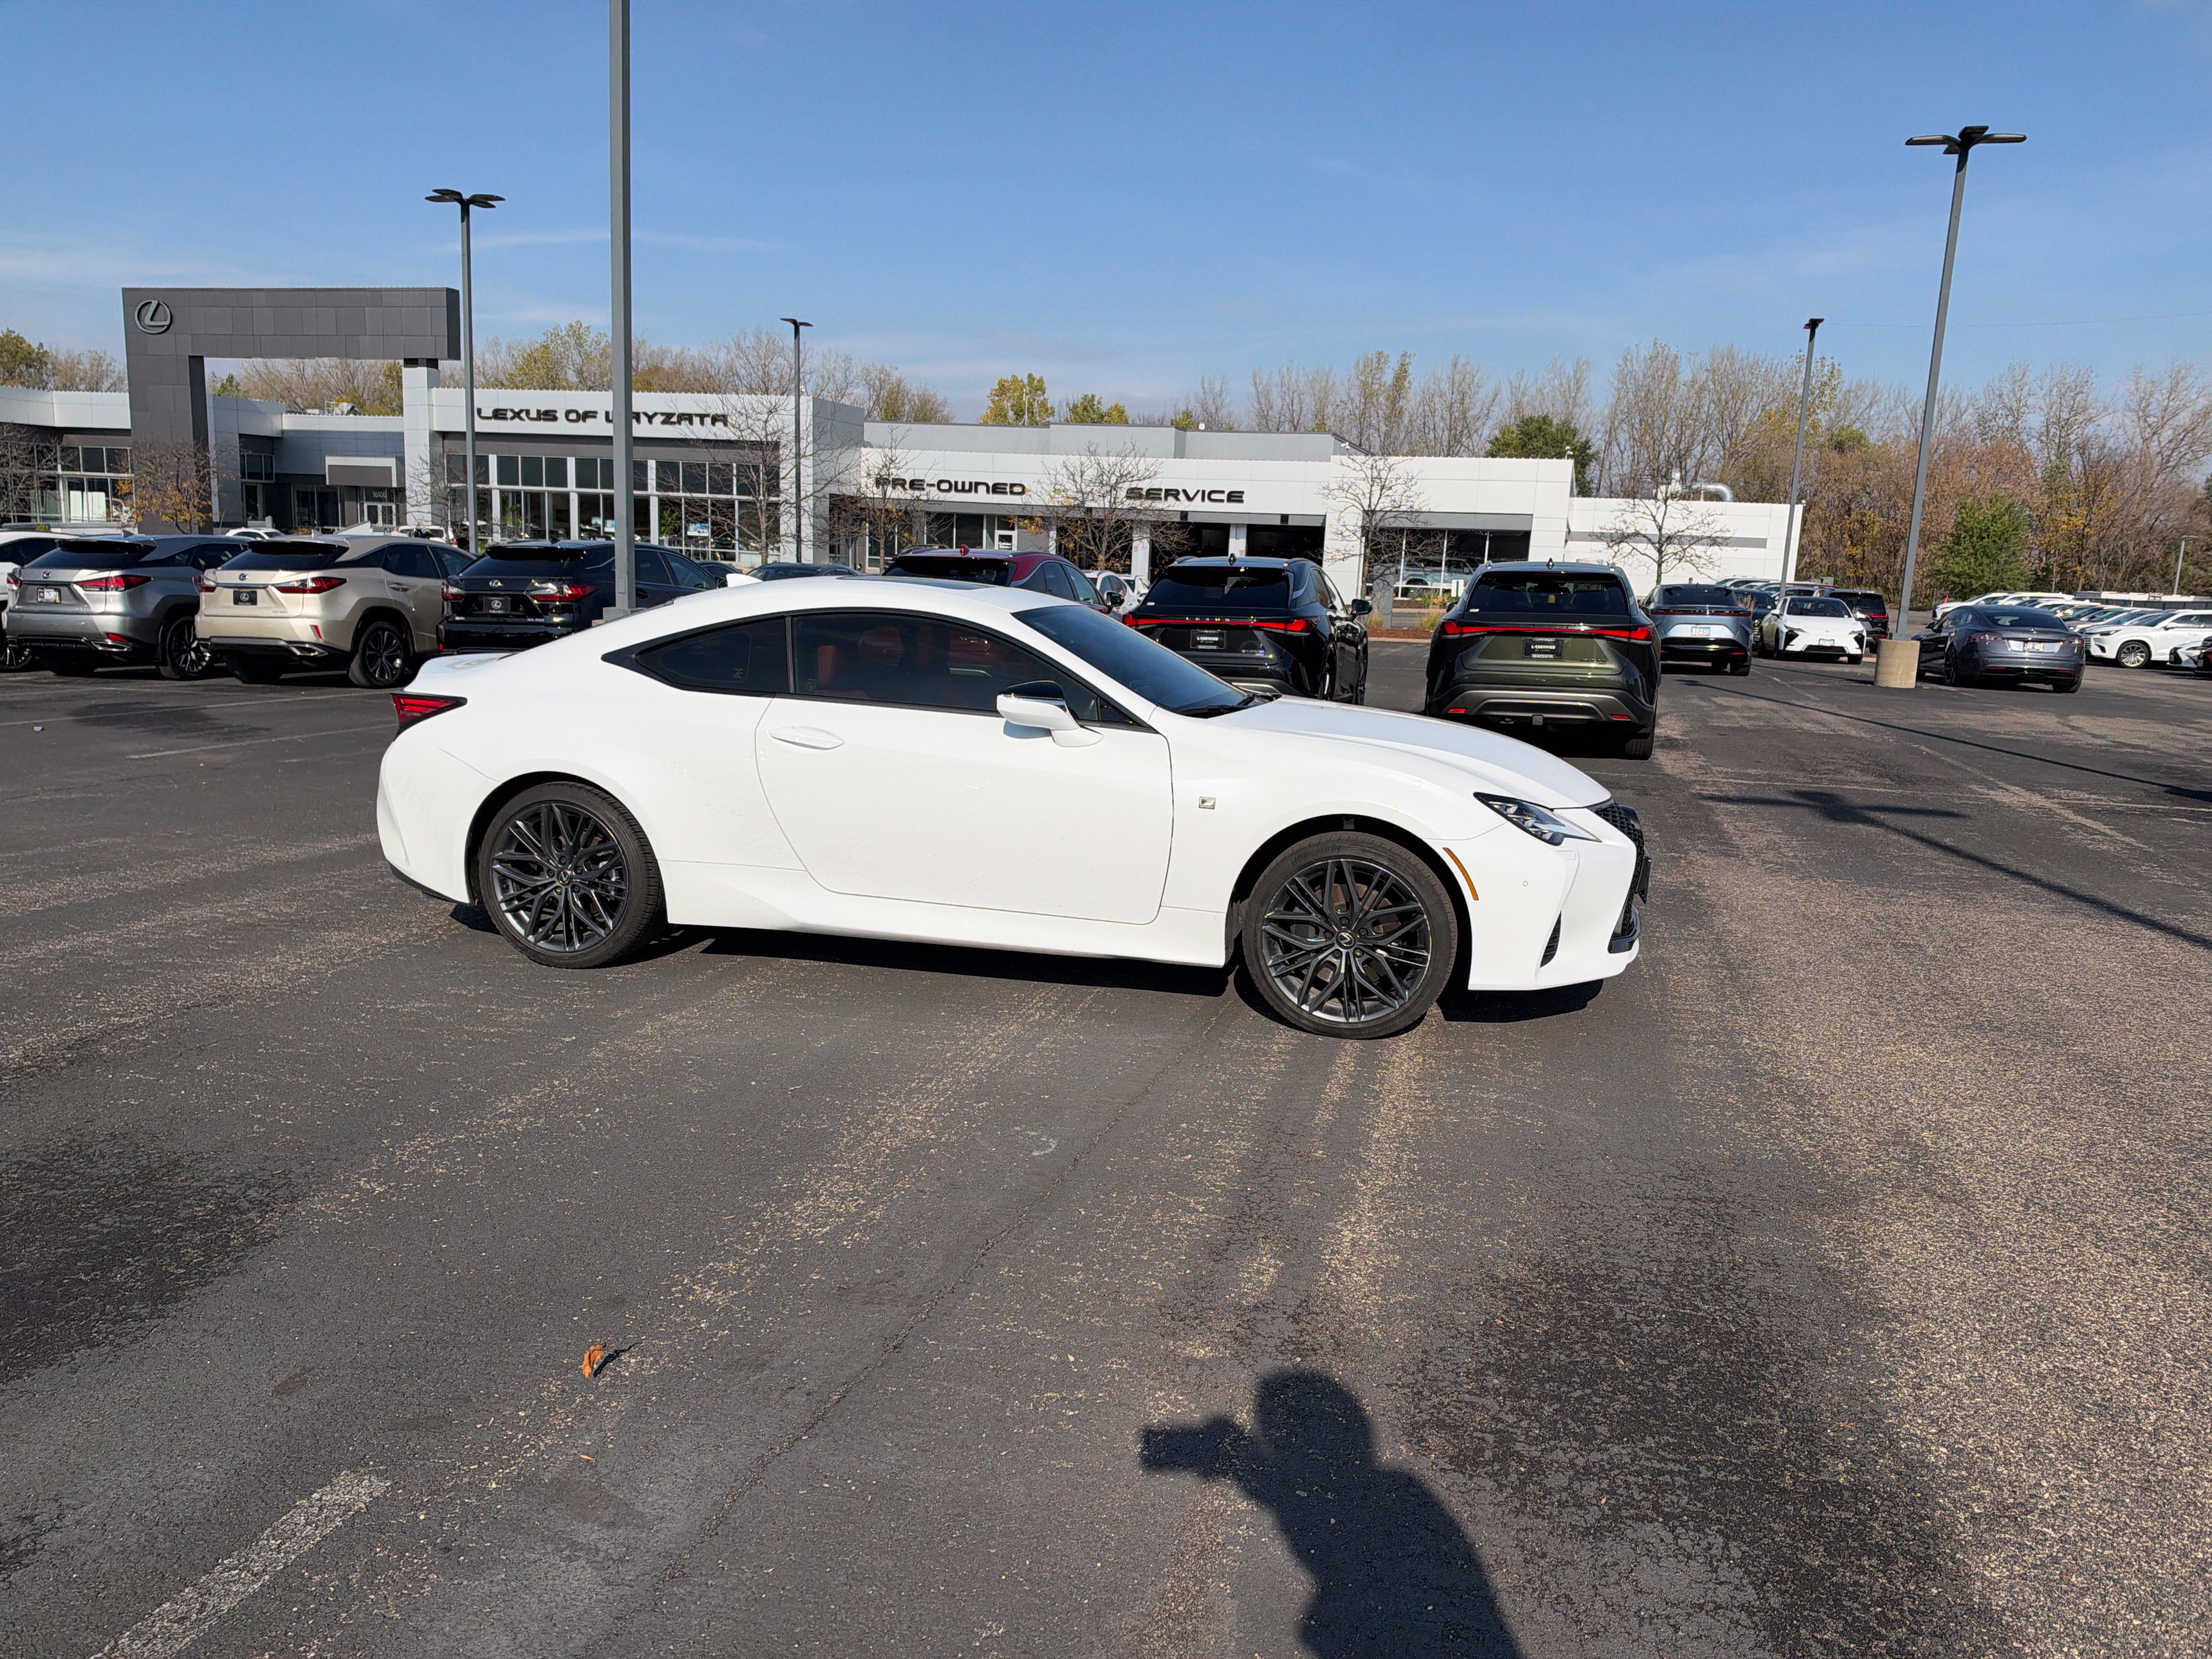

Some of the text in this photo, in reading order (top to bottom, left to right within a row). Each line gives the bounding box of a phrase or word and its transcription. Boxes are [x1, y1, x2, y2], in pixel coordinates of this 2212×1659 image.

[476, 408, 558, 422] LEXUS
[565, 409, 598, 423] OF
[875, 477, 1026, 495] PRE-OWNED
[1126, 487, 1245, 504] SERVICE
